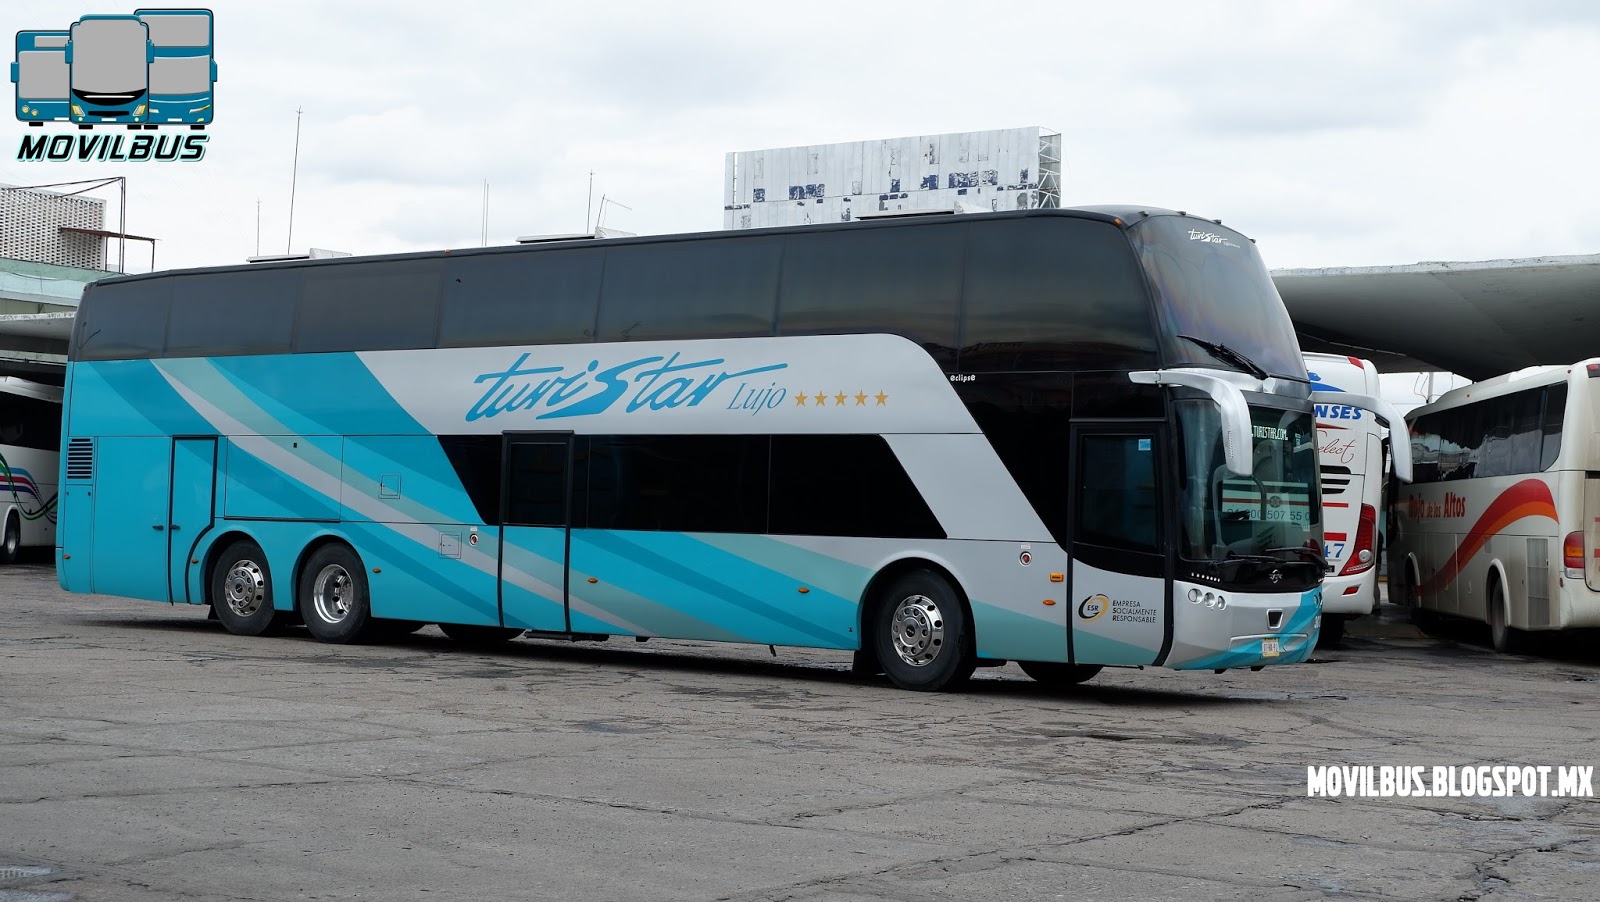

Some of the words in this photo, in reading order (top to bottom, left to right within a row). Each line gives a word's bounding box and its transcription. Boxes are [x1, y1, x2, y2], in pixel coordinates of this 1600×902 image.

[726, 382, 787, 416] Lujo
[1443, 491, 1466, 518] Altos
[1267, 510, 1286, 520] 507
[1290, 511, 1302, 521] 55
[1087, 604, 1099, 612] ESR
[1112, 599, 1141, 608] EMPRESA
[1112, 607, 1157, 616] SOCIALMENTE
[1112, 614, 1156, 624] RESPONSABLE
